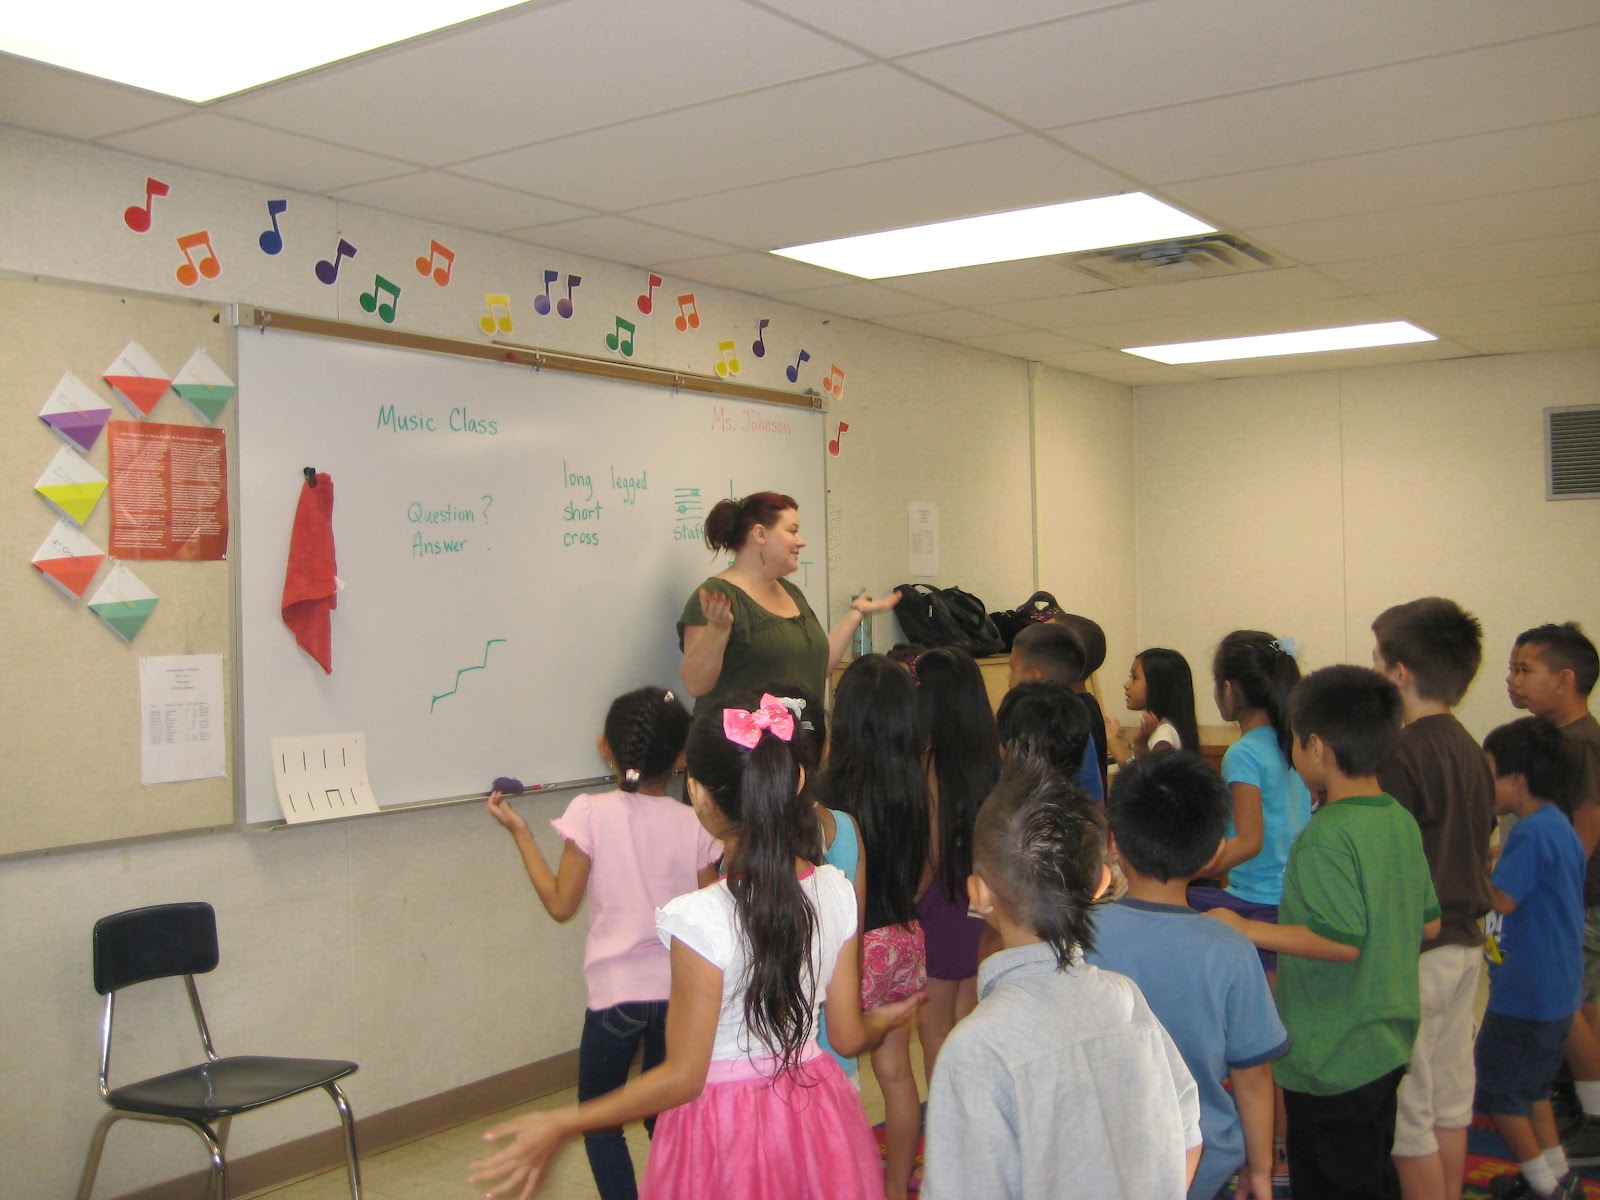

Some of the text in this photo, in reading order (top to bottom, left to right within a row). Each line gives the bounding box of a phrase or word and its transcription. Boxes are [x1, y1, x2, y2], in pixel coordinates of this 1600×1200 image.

[376, 403, 498, 435] Music Class
[711, 405, 792, 436] Ms. Johnson
[562, 459, 648, 505] long legged
[562, 499, 603, 522] short
[412, 530, 467, 557] Answer
[562, 531, 600, 547] cross
